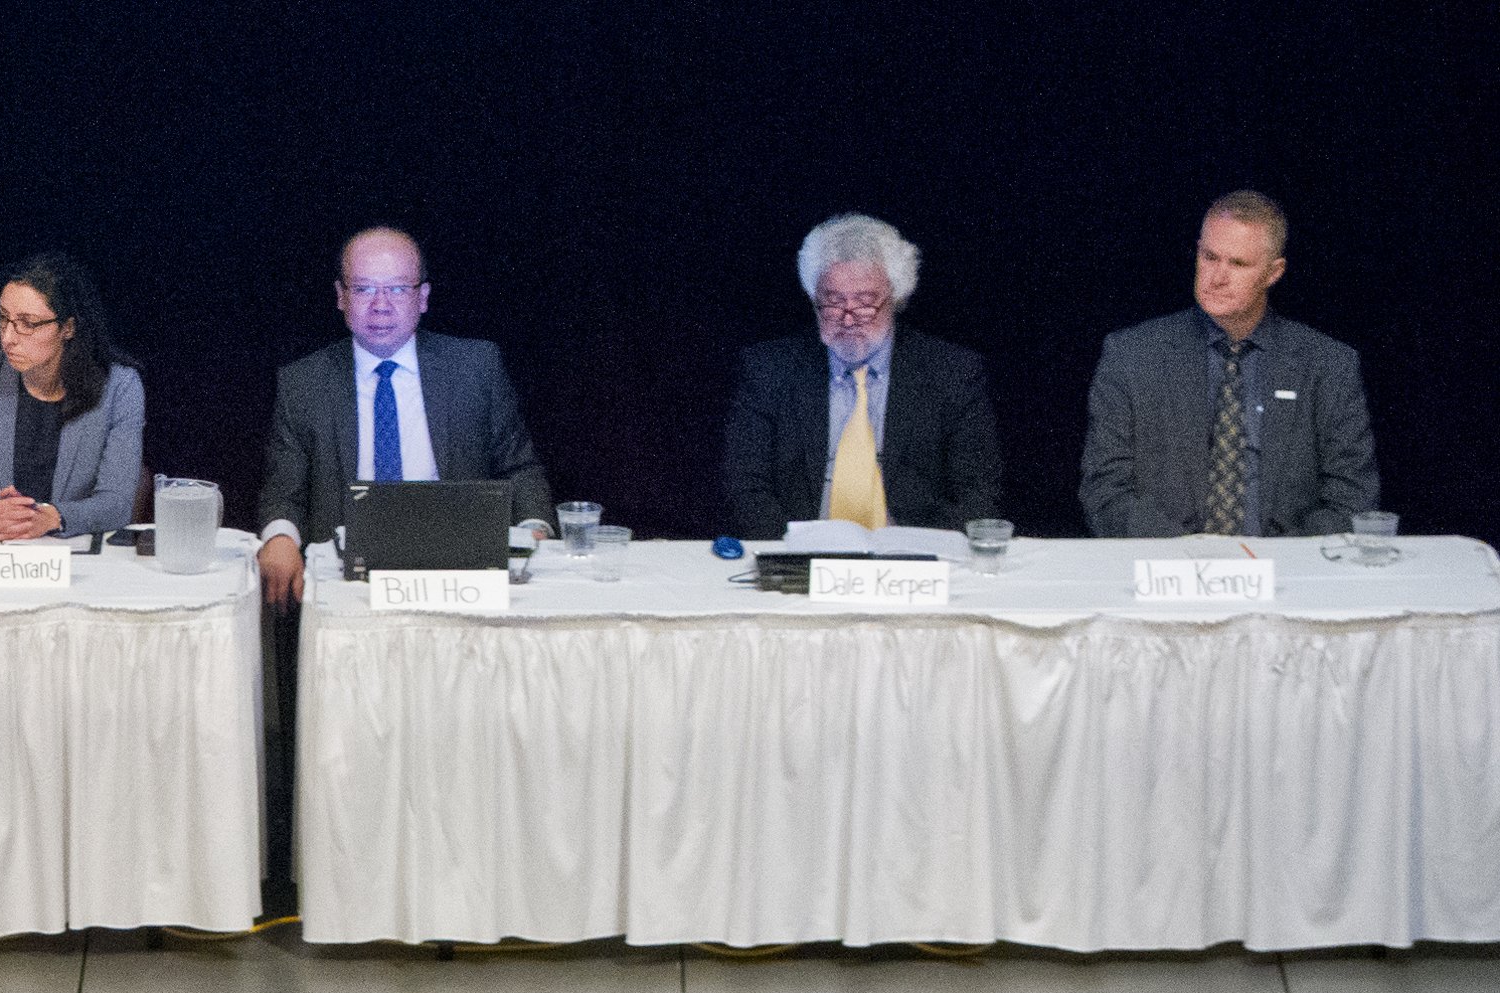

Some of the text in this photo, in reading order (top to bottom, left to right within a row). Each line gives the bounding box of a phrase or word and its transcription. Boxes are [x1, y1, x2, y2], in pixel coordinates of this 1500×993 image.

[380, 577, 481, 605] Bill Ho
[814, 566, 946, 603] Dale Kerper
[1136, 562, 1263, 599] Jim Kenny
